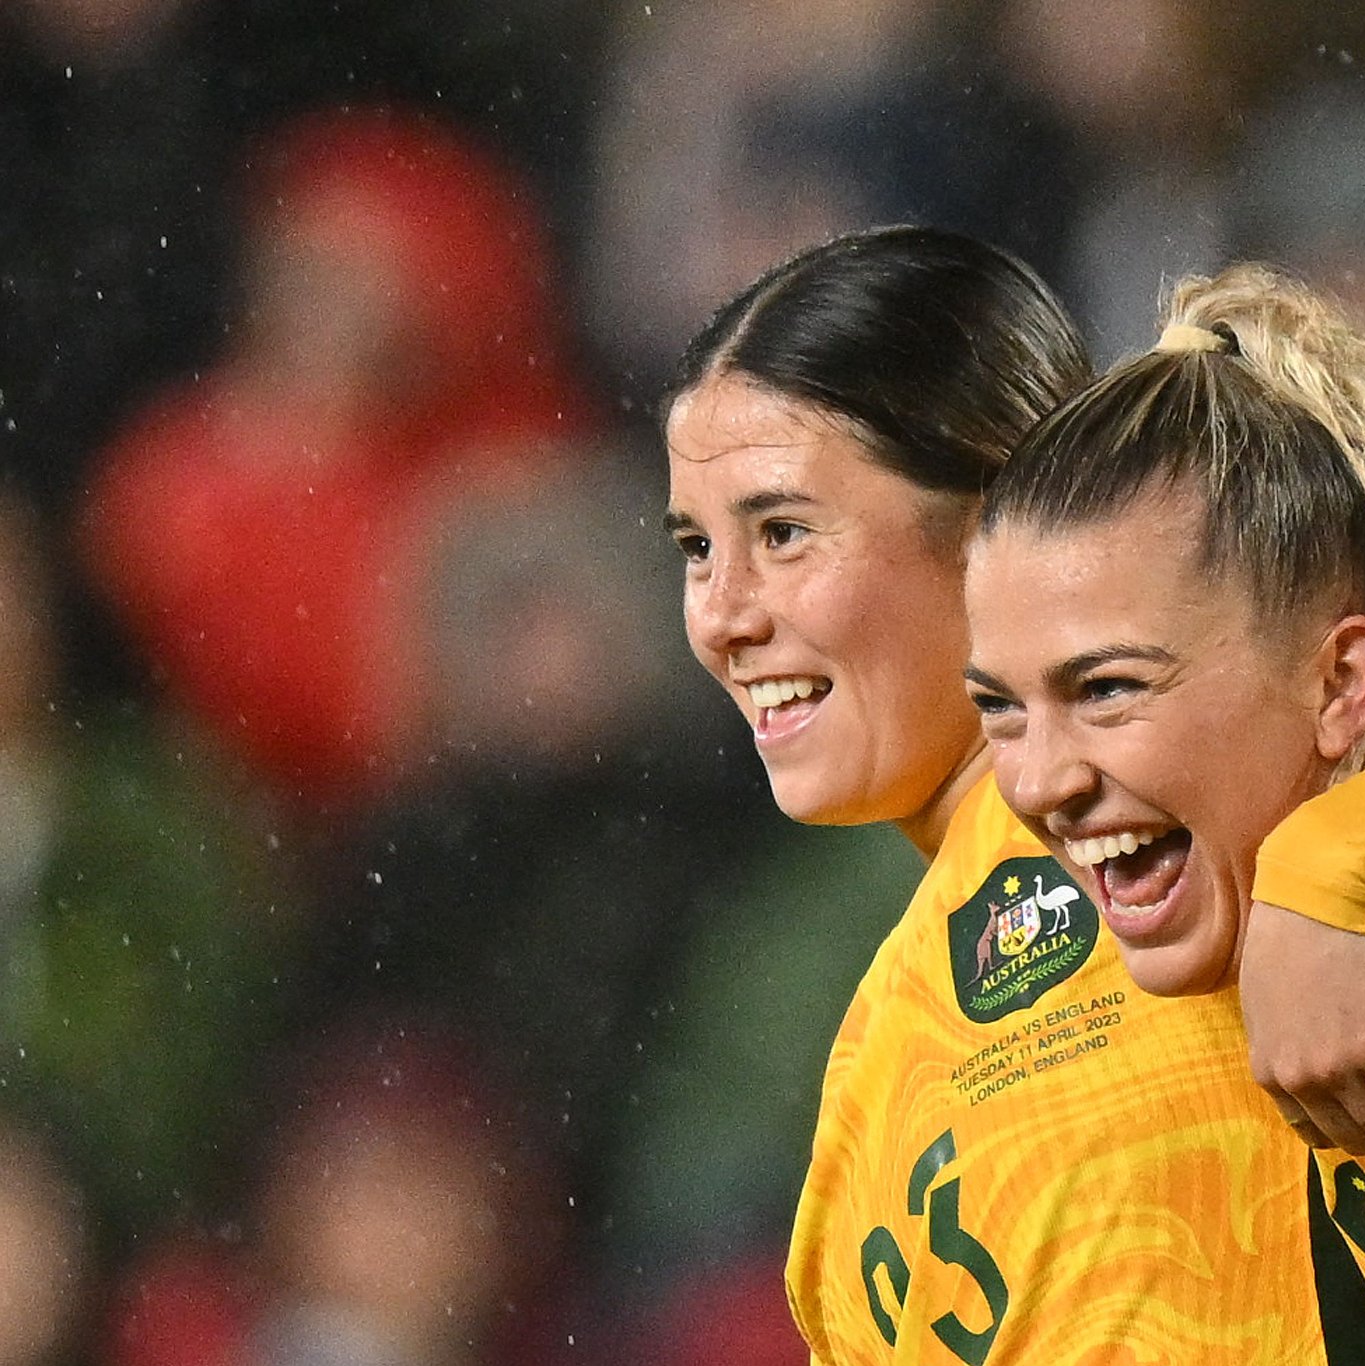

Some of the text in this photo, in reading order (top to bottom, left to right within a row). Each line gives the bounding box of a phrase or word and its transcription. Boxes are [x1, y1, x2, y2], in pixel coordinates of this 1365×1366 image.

[980, 932, 1072, 994] AUSTRALIA
[950, 991, 1126, 1083] AUSTRALIA VS ENGLAND
[956, 1012, 1122, 1095] TUESDAY 11 APRIL 2023
[970, 1034, 1108, 1107] LONDON, ENGLAND
